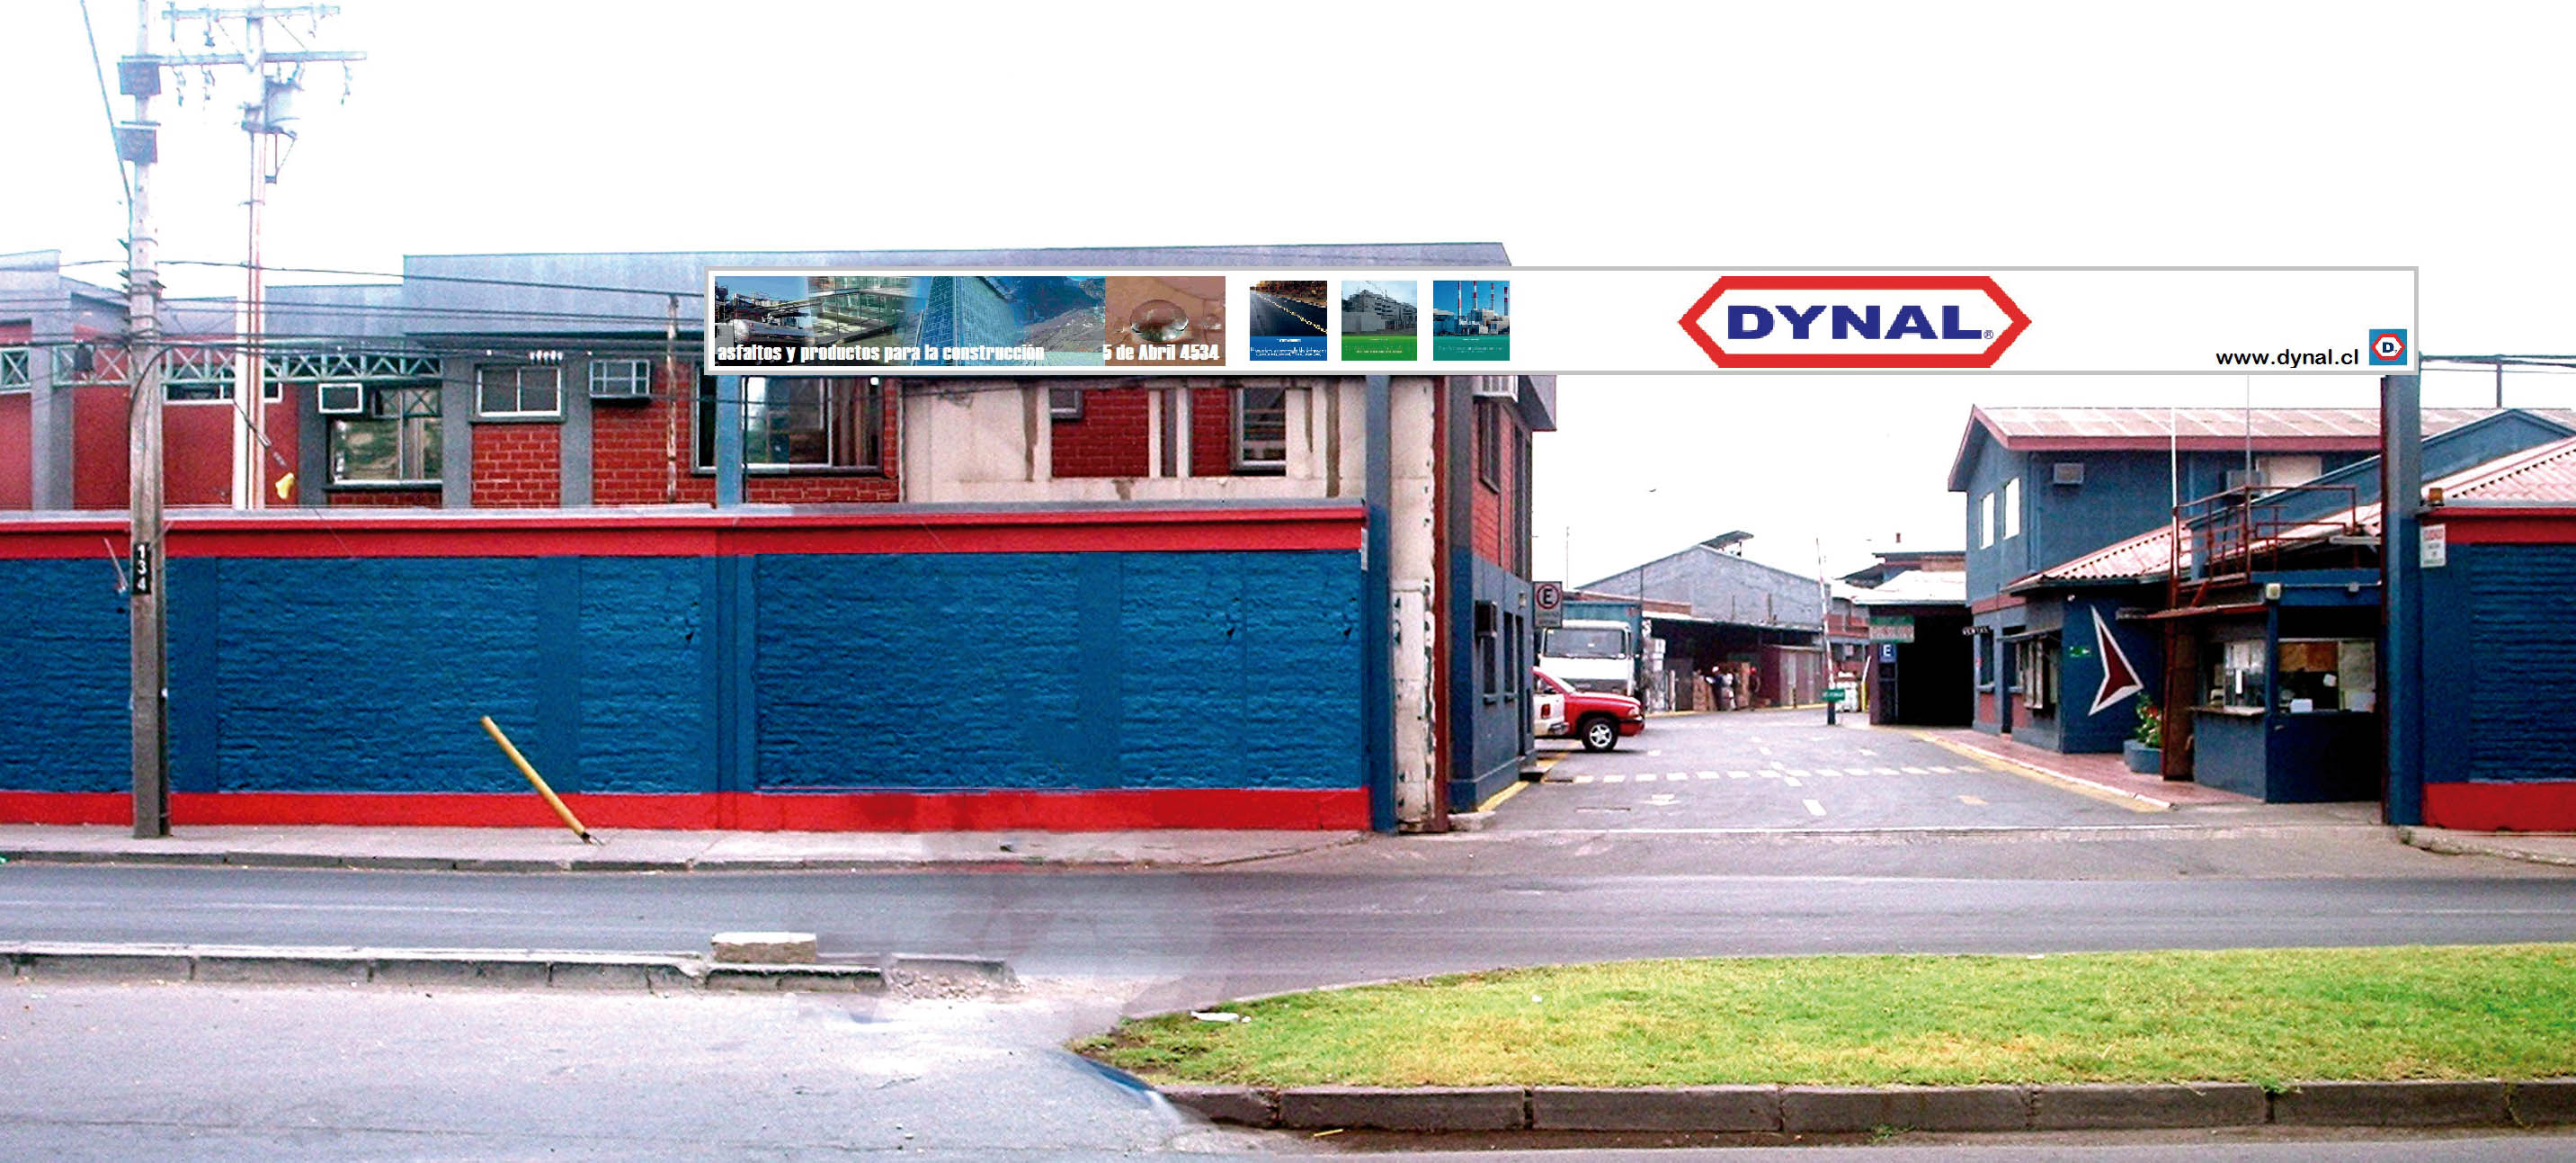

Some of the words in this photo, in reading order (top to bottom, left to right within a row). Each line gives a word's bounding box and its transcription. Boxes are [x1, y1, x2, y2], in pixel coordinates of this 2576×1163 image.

[717, 344, 782, 361] asfaltos
[785, 346, 797, 363] y
[799, 344, 881, 363] productos
[884, 345, 921, 363] para
[924, 344, 939, 361] la
[941, 344, 1045, 361] construcción
[1102, 344, 1113, 361] 5
[1116, 344, 1135, 361] de
[1137, 344, 1176, 361] Abril
[1179, 344, 1220, 361] 4534
[2215, 348, 2359, 369] www.dynal.cl
[137, 543, 147, 591] 134
[1543, 588, 1554, 604] E
[1883, 644, 1892, 657] E
